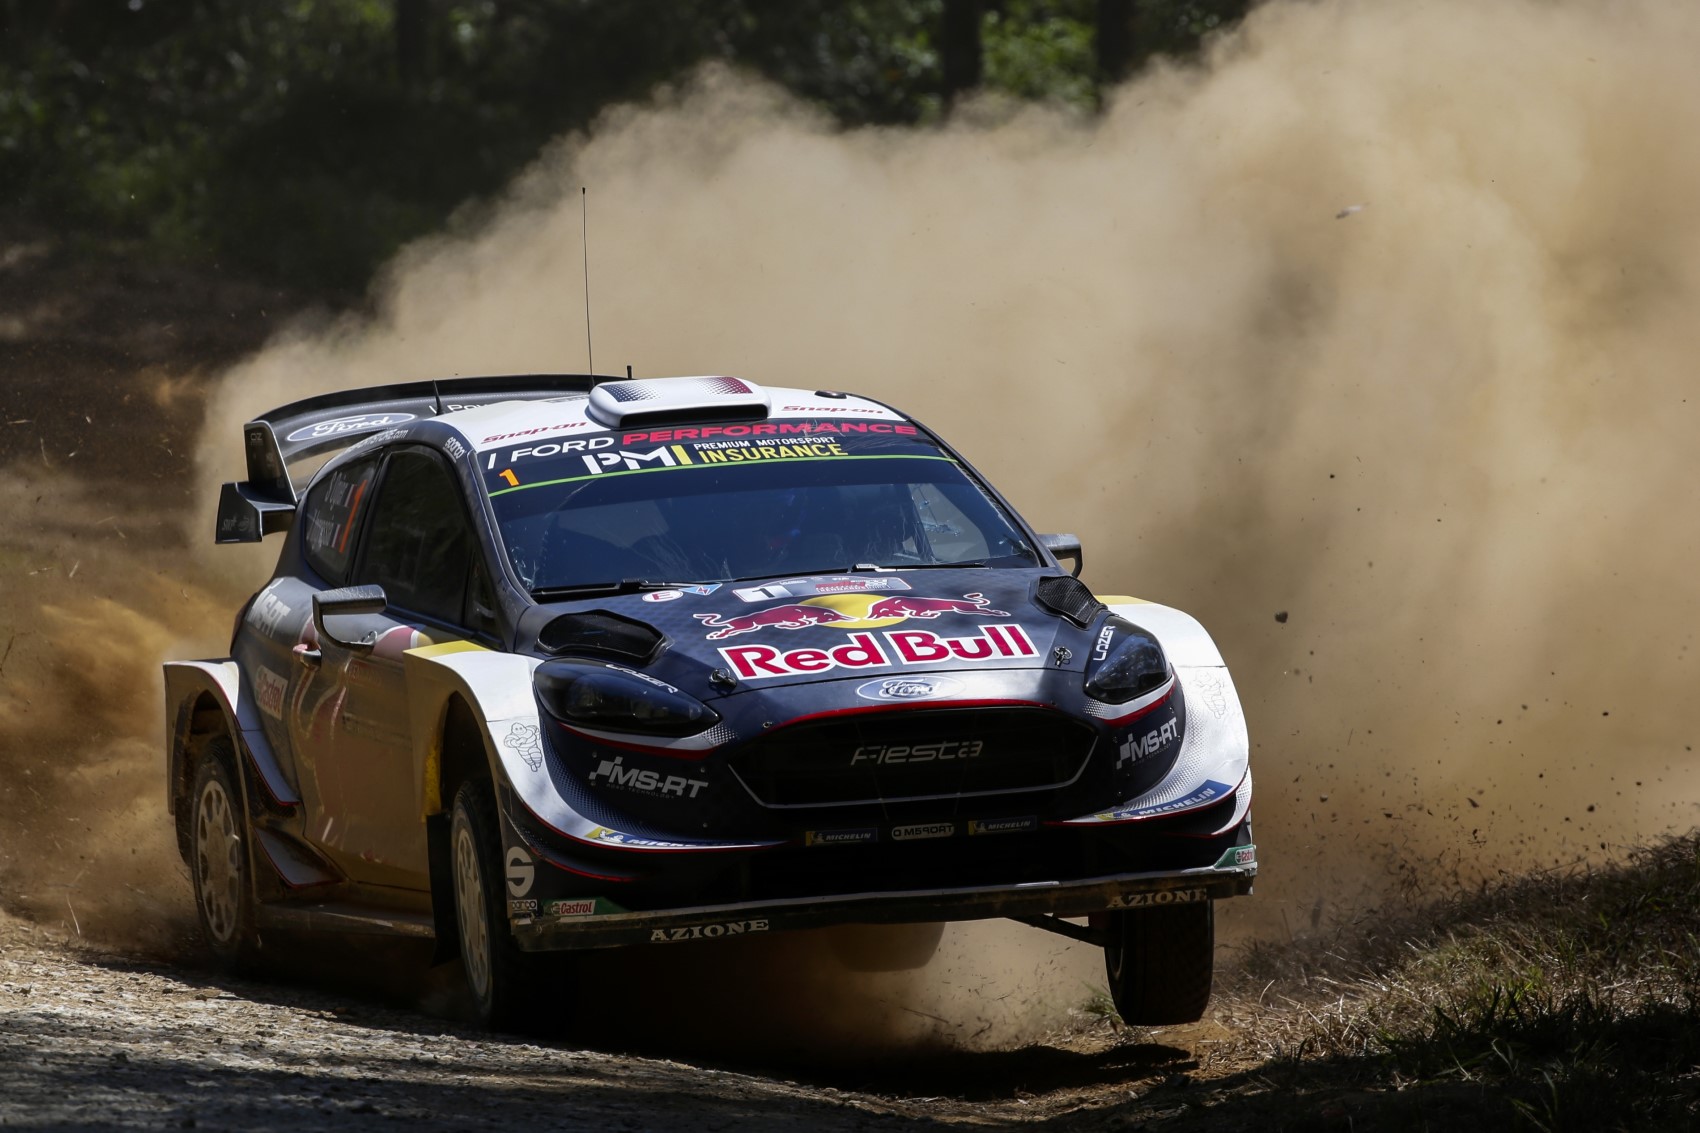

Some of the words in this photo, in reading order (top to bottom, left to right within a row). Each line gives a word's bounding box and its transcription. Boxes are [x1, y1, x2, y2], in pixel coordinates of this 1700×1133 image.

[312, 416, 392, 436] Ford
[511, 437, 615, 463] FORD
[622, 422, 918, 445] PERFORMANCE
[694, 440, 751, 450] PREMIUM
[755, 436, 836, 447] MOTORSPORT
[582, 444, 693, 475] PMI
[699, 444, 848, 464] INSURANCE
[499, 469, 519, 486] 1
[653, 591, 676, 600] E
[751, 587, 776, 599] 1
[720, 632, 889, 679] Red
[886, 624, 1038, 664] Bull
[879, 677, 943, 698] Ford
[1138, 787, 1216, 815] MICHELIN
[988, 820, 1031, 830] MICHELIN
[825, 832, 871, 841] MICHELIN
[560, 902, 593, 915] Castrol
[1106, 888, 1208, 909] AZIONE
[651, 919, 769, 942] AZIONE
